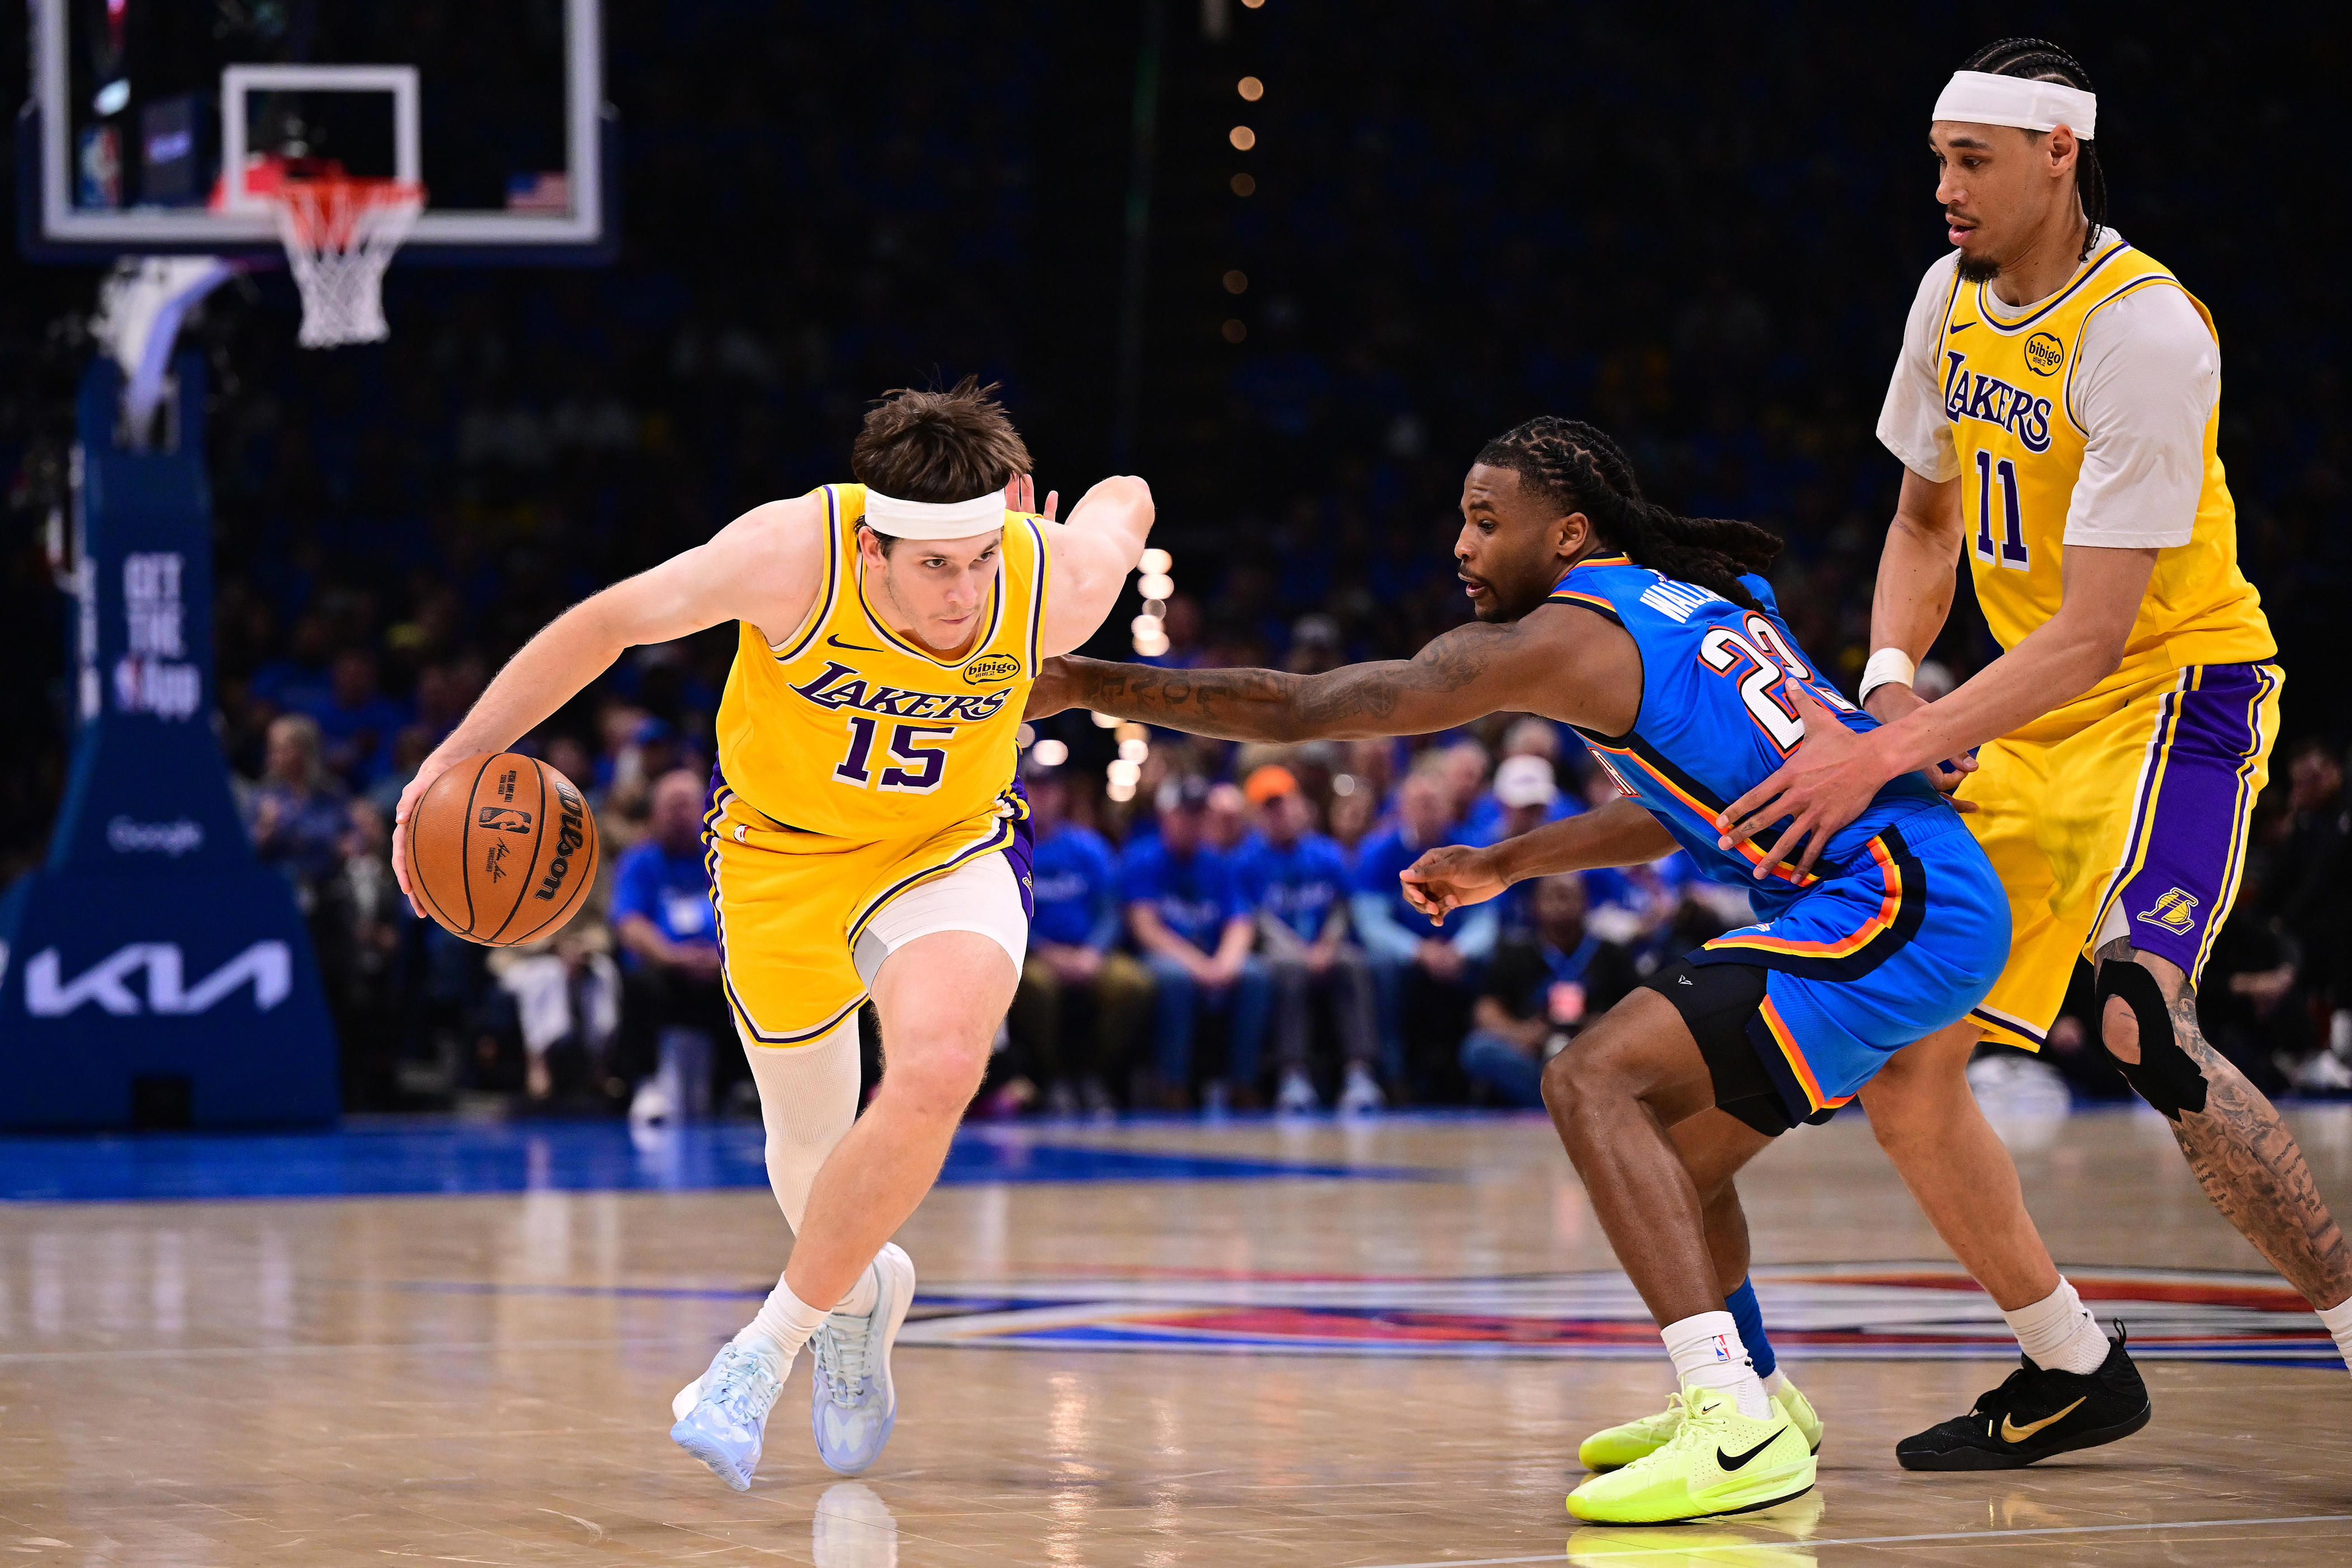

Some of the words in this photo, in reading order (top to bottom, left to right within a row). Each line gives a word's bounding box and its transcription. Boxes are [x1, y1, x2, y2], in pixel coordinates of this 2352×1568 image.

[2029, 341, 2061, 366] bibigo
[2033, 356, 2046, 367] 비비고
[1944, 349, 2053, 455] LAKERS
[1975, 448, 2030, 572] 11
[1639, 579, 1735, 624] WALLA
[786, 660, 1016, 721] LAKERS
[969, 662, 1017, 676] bibigo
[831, 716, 958, 795] 15
[534, 781, 583, 901] Wilson
